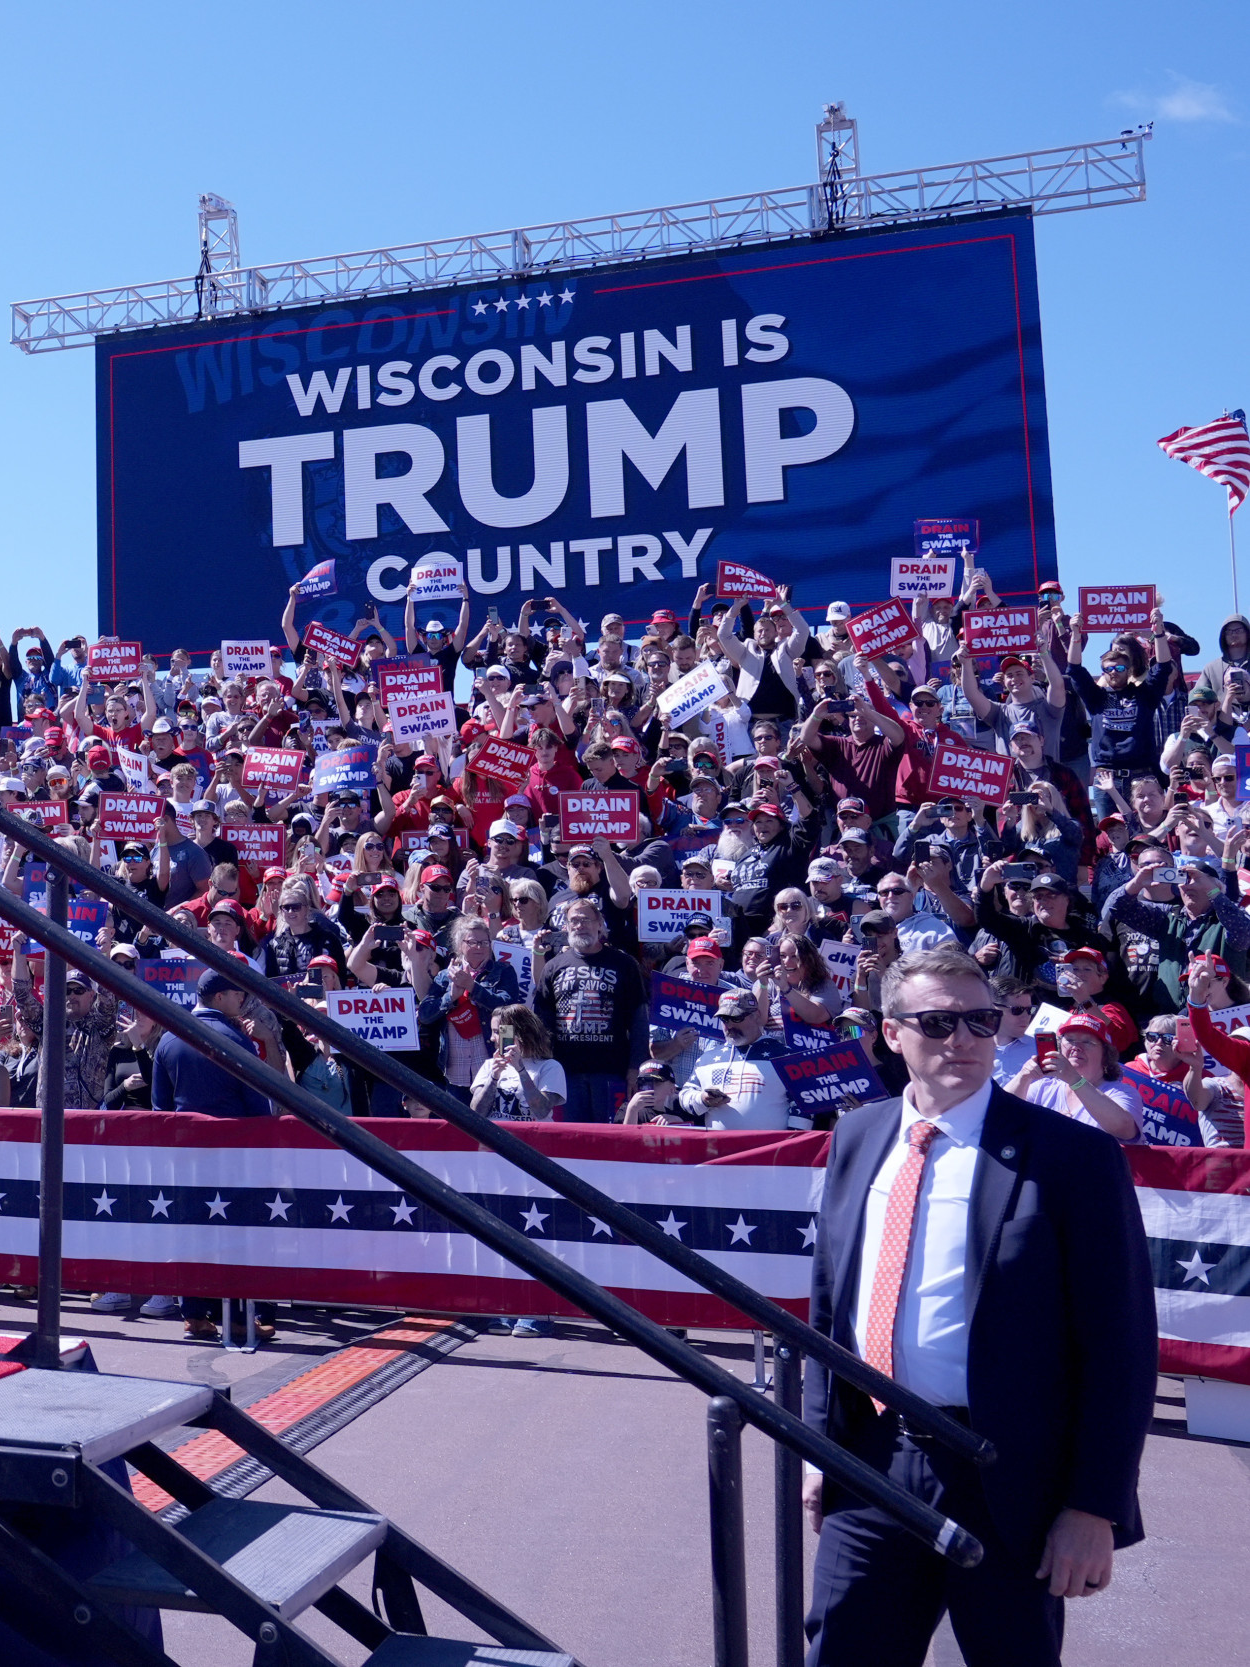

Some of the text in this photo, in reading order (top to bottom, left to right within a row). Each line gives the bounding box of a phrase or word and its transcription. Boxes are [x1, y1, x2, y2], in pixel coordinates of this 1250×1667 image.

[286, 312, 791, 417] WISCONSIN IS
[239, 378, 856, 548] TRUMP
[921, 524, 970, 534] DRAIN
[921, 539, 970, 549] SWAMP
[417, 568, 457, 580] DRAIN
[725, 565, 770, 584] DRAIN
[899, 564, 948, 574] DRAIN
[741, 576, 756, 584] THE
[300, 581, 331, 594] SWAMP
[416, 584, 457, 594] SWAMP
[723, 582, 773, 594] SWAMP
[898, 583, 946, 591] SWAMP
[1087, 592, 1147, 605] DRAIN
[852, 604, 900, 638] DRAIN
[970, 612, 1029, 629] DRAIN
[1087, 613, 1148, 625] SWAMP
[871, 624, 889, 636] THE
[313, 628, 357, 651] DRAIN
[326, 640, 339, 650] THE
[860, 625, 910, 655] SWAMP
[971, 635, 1031, 650] SWAMP
[92, 646, 136, 659] DRAIN
[227, 646, 264, 655] DRAIN
[309, 639, 352, 661] SWAMP
[91, 664, 137, 675] SWAMP
[227, 662, 266, 671] SWAMP
[378, 659, 424, 672] DRAIN
[385, 671, 435, 686] DRAIN
[664, 669, 710, 704] DRAIN
[682, 688, 697, 698] THE
[386, 690, 437, 702] SWAMP
[671, 684, 716, 718] SWAMP
[396, 699, 446, 718] DRAIN
[416, 714, 431, 722] THE
[400, 718, 449, 735] SWAMP
[715, 722, 727, 767] DRAIN
[250, 752, 297, 767] DRAIN
[320, 751, 369, 769] DRAIN
[486, 742, 530, 766] DRAIN
[264, 764, 279, 772] THE
[336, 764, 350, 772] THE
[498, 759, 512, 767] THE
[942, 751, 1005, 776] DRAIN
[476, 759, 522, 781] SWAMP
[962, 770, 982, 780] THE
[247, 771, 293, 784] SWAMP
[319, 770, 369, 786] SWAMP
[937, 775, 1000, 797] SWAMP
[105, 798, 157, 814] DRAIN
[568, 797, 631, 812] DRAIN
[104, 820, 155, 834] SWAMP
[568, 822, 631, 835] SWAMP
[227, 829, 279, 842] DRAIN
[237, 851, 279, 861] WAMP
[648, 897, 711, 911] DRAIN
[648, 921, 689, 932] SWA
[517, 956, 531, 1003] WAMP
[165, 983, 185, 991] THE
[562, 980, 615, 994] MY SAVIOR
[338, 997, 406, 1015] DRAIN
[685, 1001, 707, 1012] THE
[363, 1016, 384, 1024] THE
[660, 1005, 722, 1031] SWAM
[569, 1034, 614, 1042] PRESIDENT
[811, 1028, 831, 1040] THE
[784, 1050, 859, 1081] DRAIN
[816, 1074, 841, 1086] THE
[800, 1078, 870, 1104] SWAMP
[1142, 1107, 1167, 1124] THE
[1142, 1119, 1191, 1146] AMP
